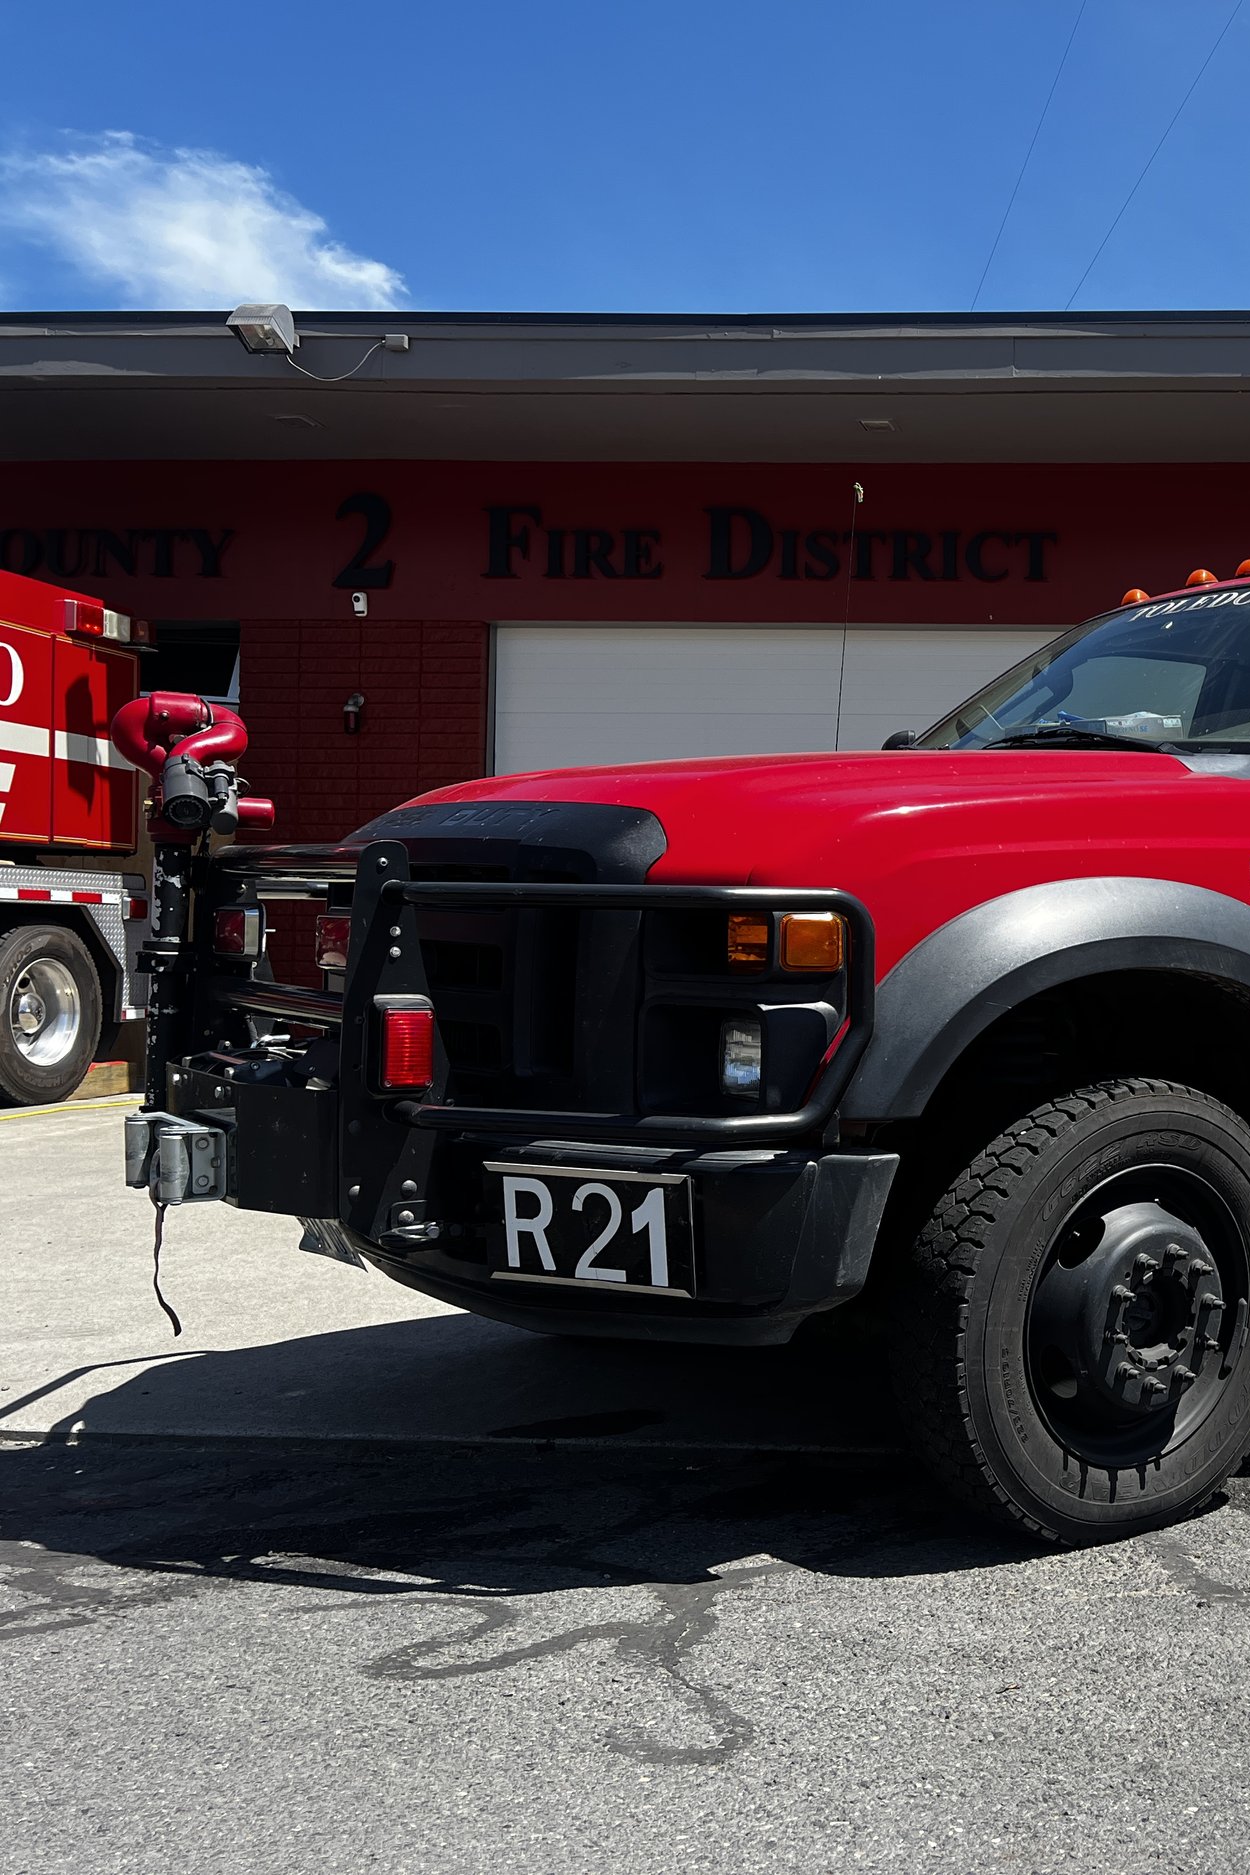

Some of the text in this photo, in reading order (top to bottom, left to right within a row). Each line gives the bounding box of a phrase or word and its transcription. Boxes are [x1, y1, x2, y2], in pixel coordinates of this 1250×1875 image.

[332, 491, 395, 589] 2
[481, 505, 664, 579] FIRE
[703, 507, 1058, 582] DISTRICT
